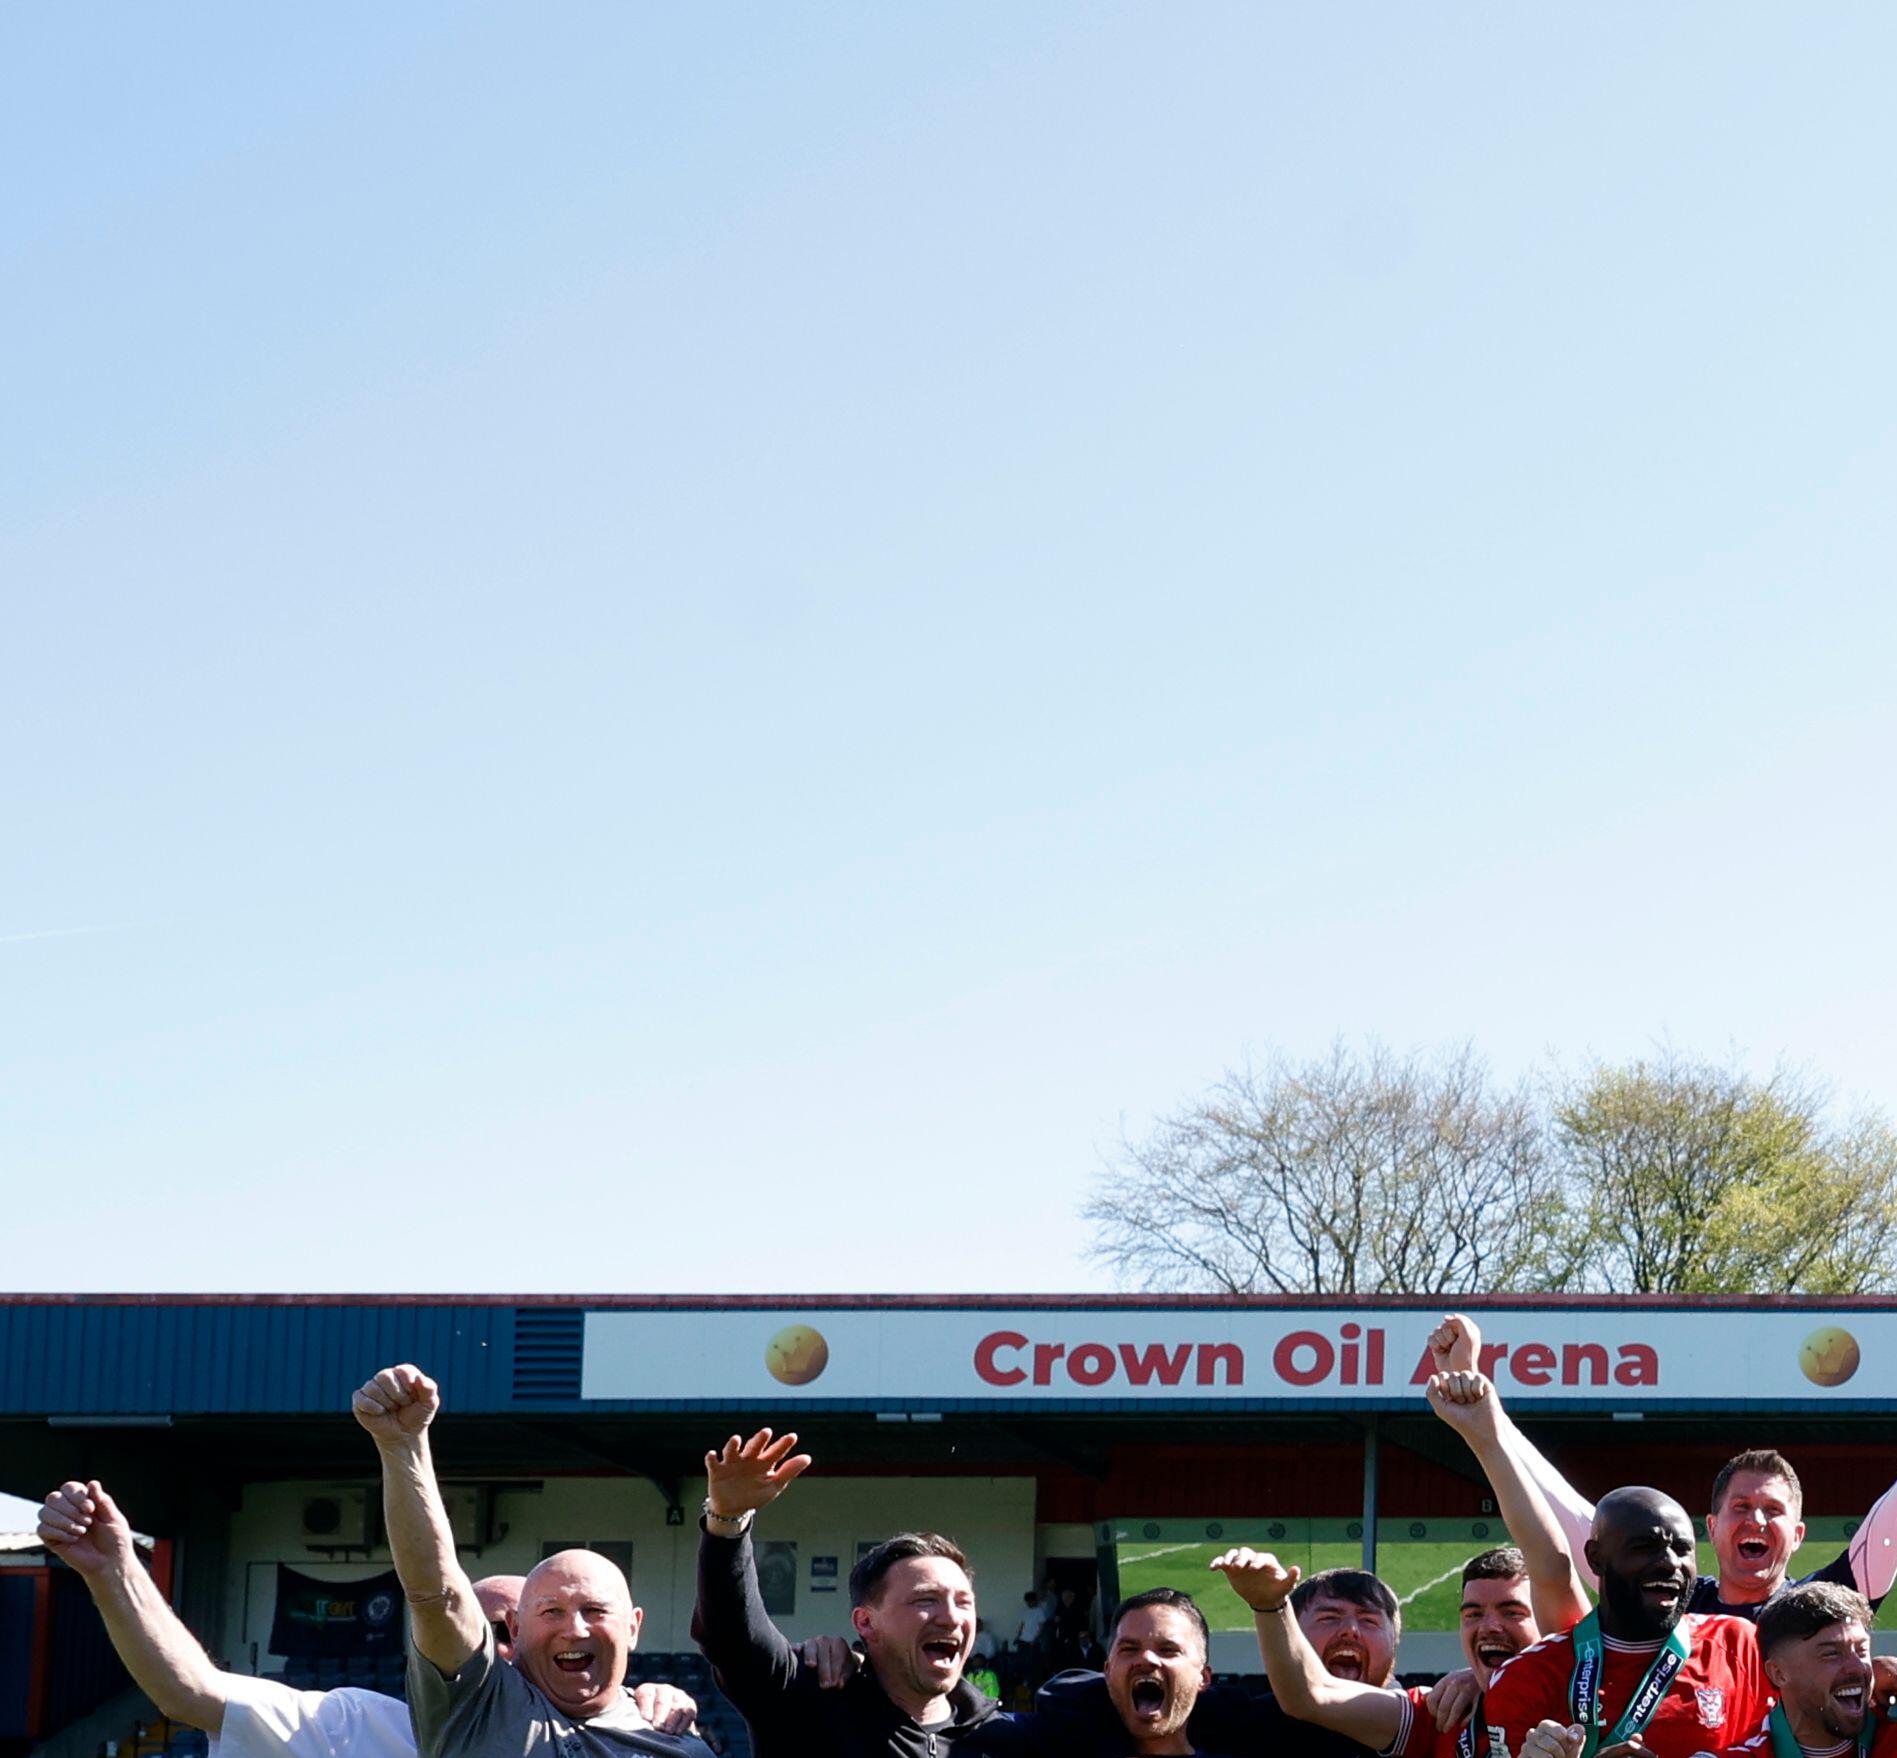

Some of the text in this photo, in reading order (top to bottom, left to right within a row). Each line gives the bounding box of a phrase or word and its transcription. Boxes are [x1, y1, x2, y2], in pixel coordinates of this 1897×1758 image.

[973, 1323, 1659, 1387] Crown Oil rena
[1576, 1639, 1597, 1725] enterprise
[1622, 1652, 1678, 1740] enterprise
